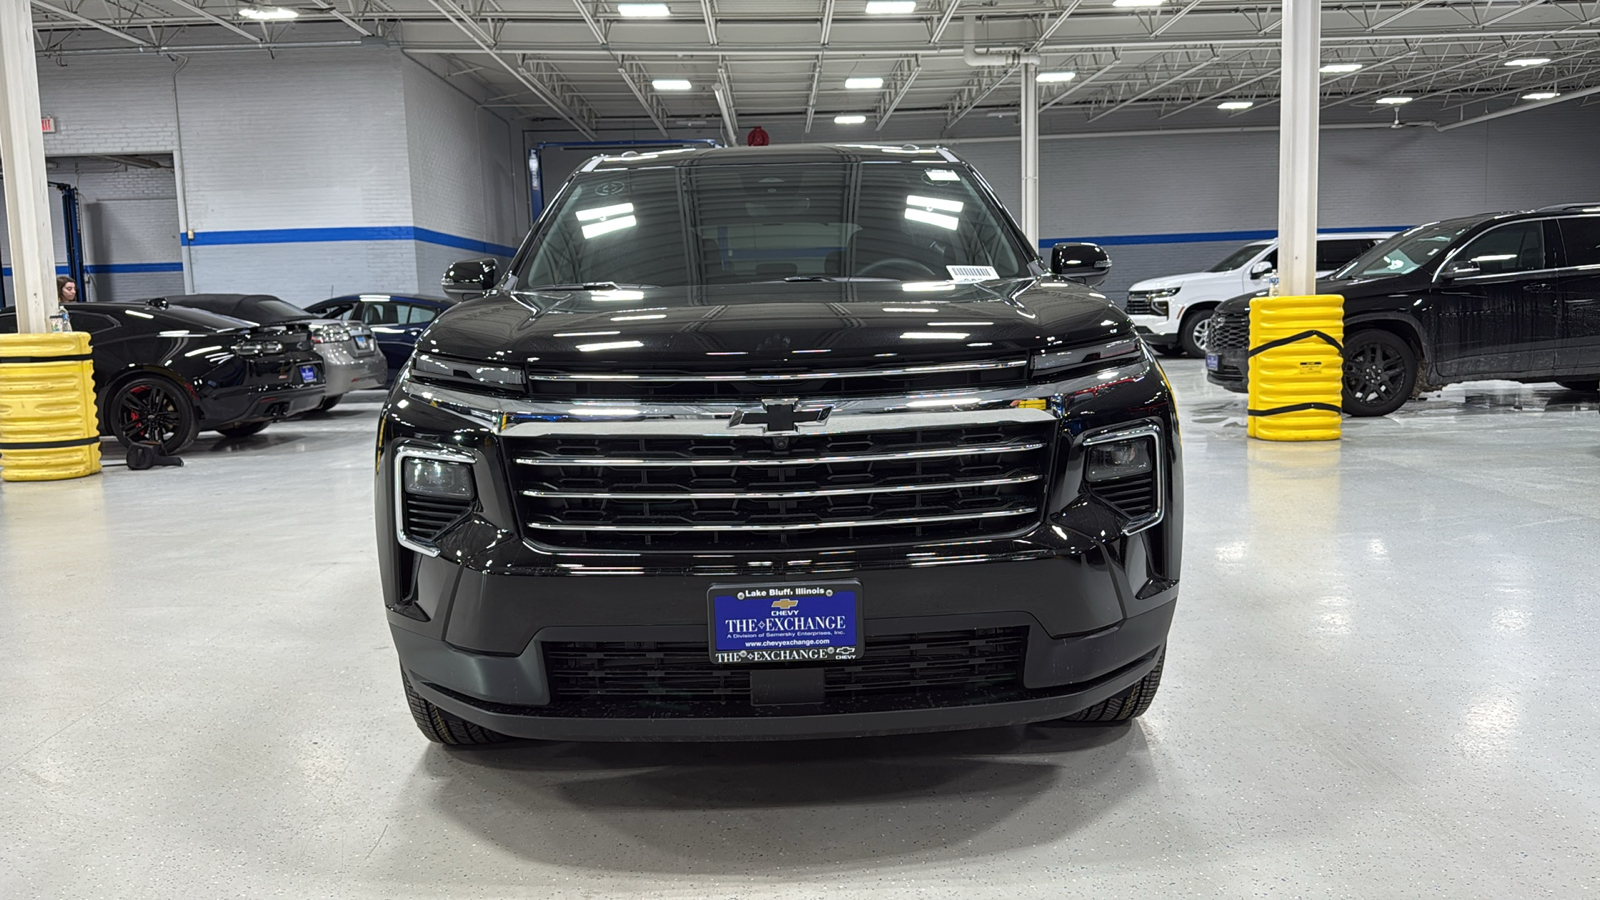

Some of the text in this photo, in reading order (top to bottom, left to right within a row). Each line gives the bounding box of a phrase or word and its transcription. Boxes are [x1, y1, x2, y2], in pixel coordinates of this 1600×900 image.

[745, 587, 825, 597] Lake Bluff, Illinois
[725, 615, 846, 633] THE EXCHANGE
[745, 639, 830, 648] www.chevyexchange.com
[715, 648, 828, 662] THE EXCHANGE
